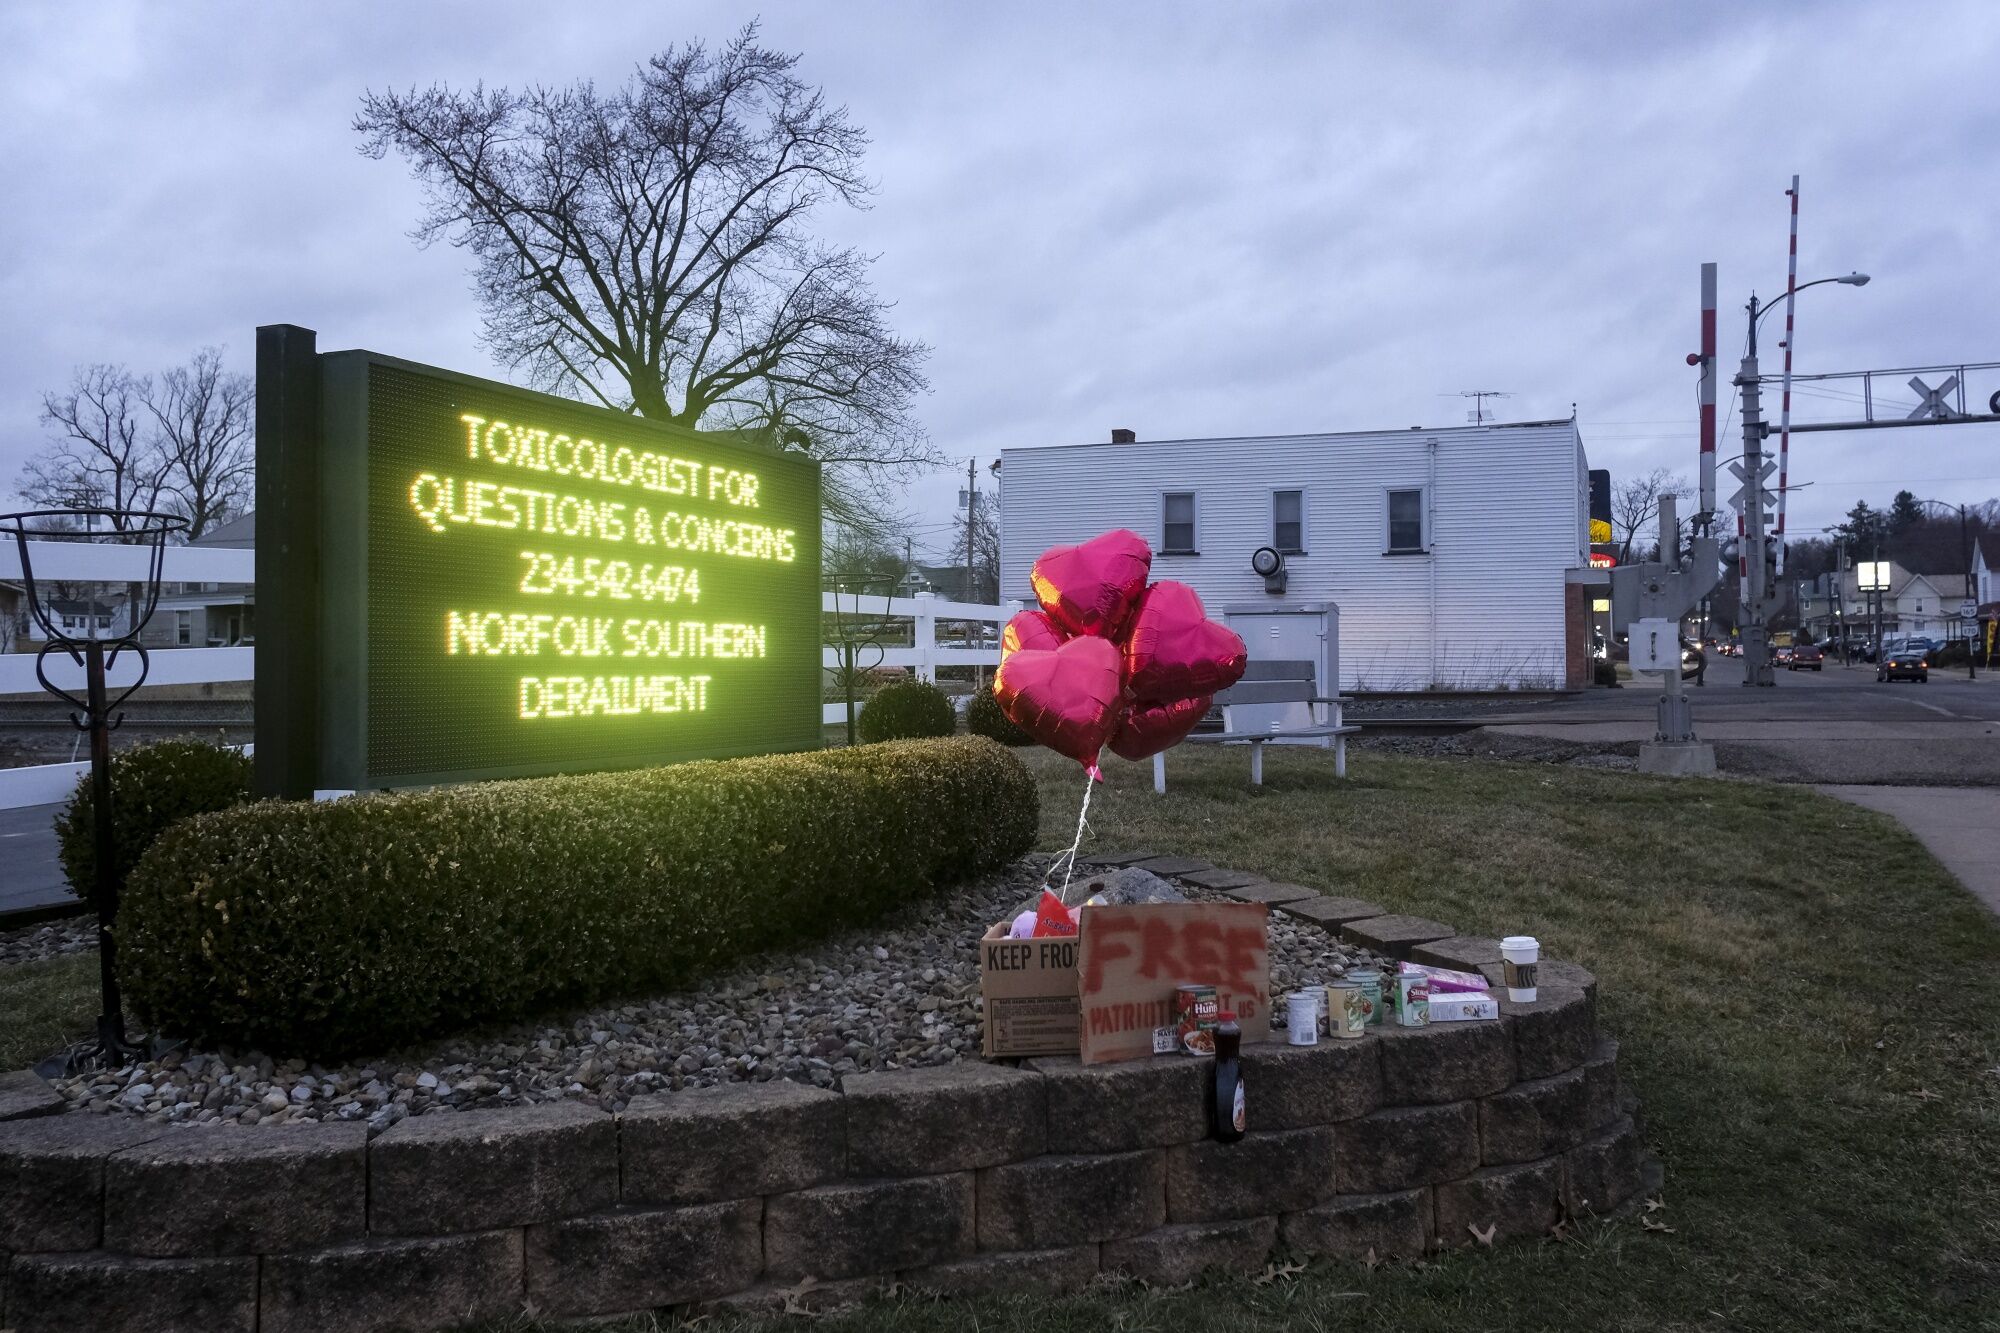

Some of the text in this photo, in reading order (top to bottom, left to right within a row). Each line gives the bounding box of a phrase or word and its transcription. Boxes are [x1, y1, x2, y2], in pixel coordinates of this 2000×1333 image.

[461, 414, 760, 508] TOXICOLOGIST FOR
[409, 472, 796, 562] QUESTIONS & CONCERNS
[446, 611, 767, 659] NORFOLK SOUTHERN
[518, 674, 712, 719] DERAILMENT
[988, 944, 1032, 971] KEEP
